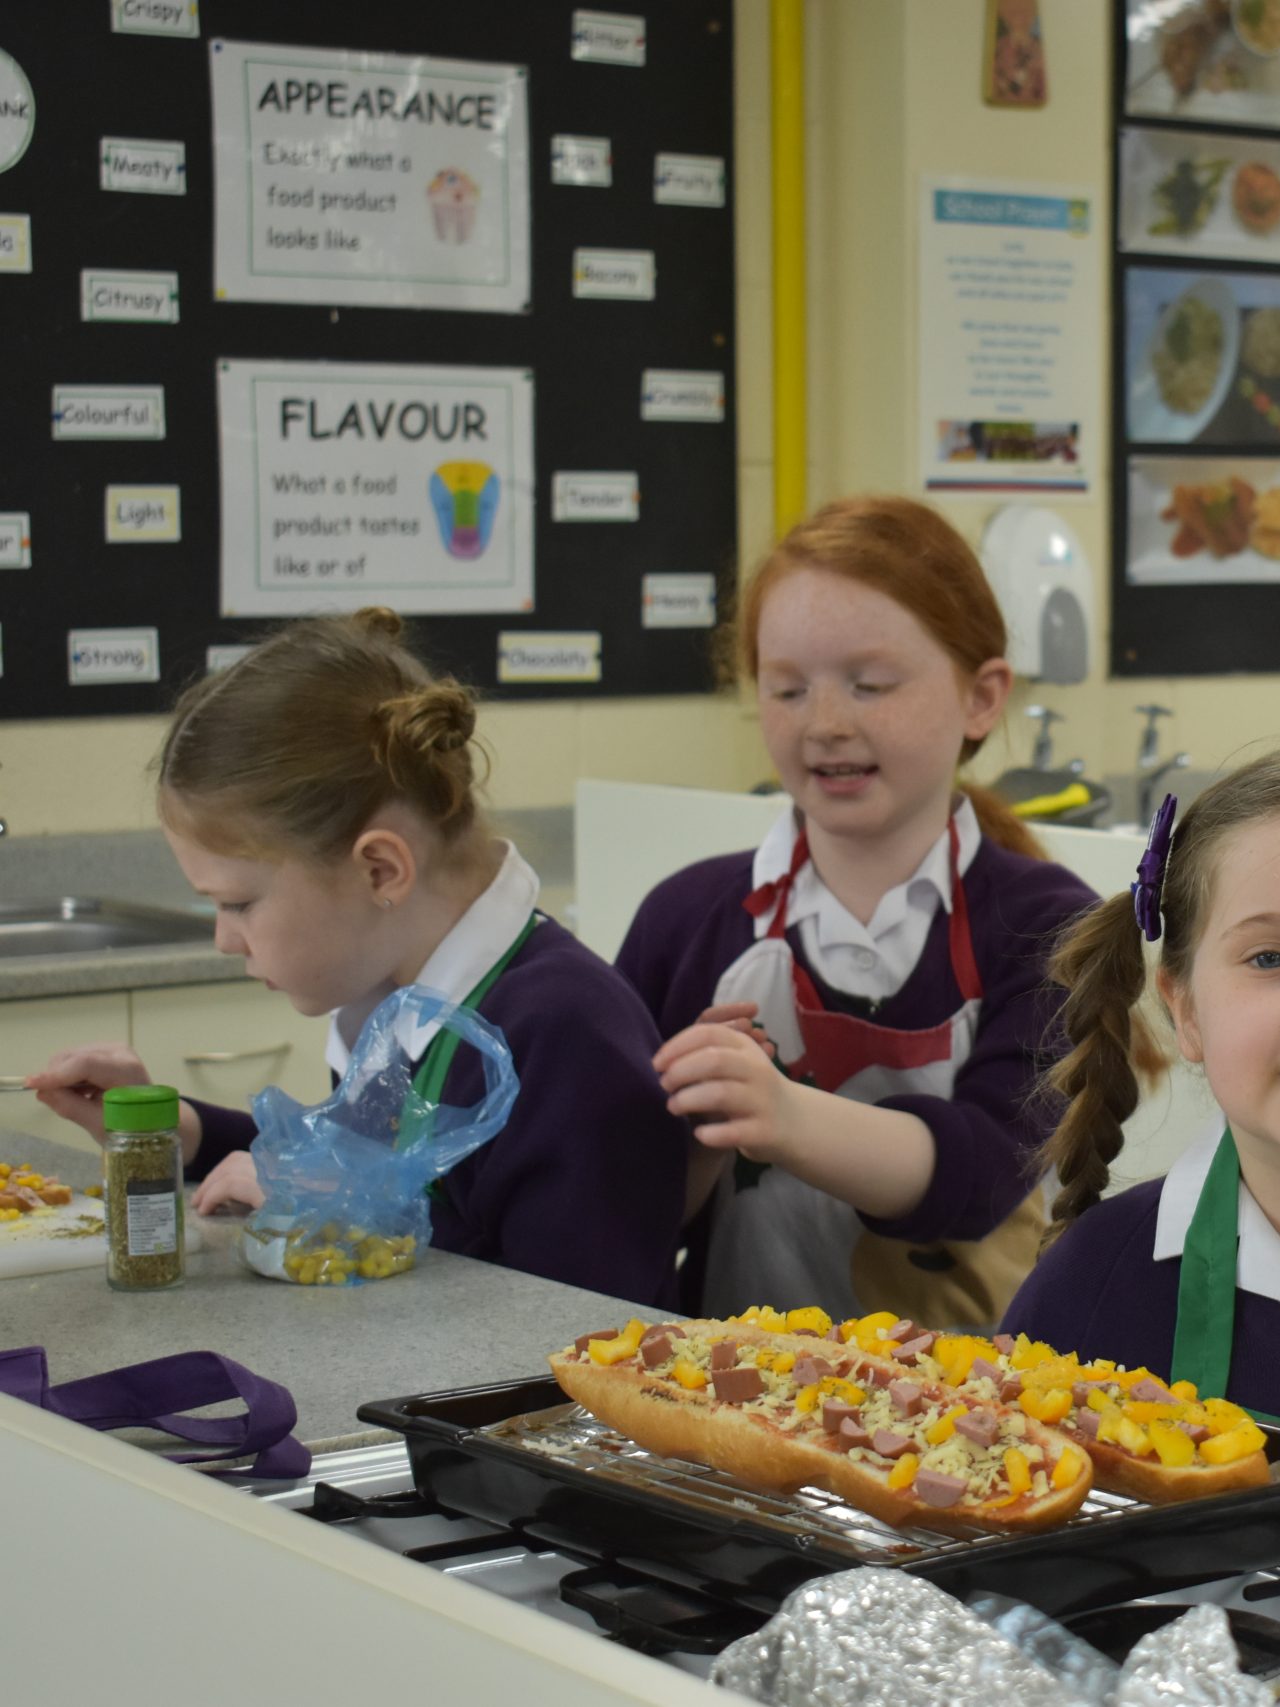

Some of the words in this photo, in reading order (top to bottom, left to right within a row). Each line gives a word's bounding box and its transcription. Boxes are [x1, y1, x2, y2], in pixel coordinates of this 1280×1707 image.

[123, 0, 184, 24] Crispy
[257, 79, 496, 131] APPEARANCE
[112, 155, 174, 181] Meaty
[263, 143, 340, 174] Exactly
[345, 151, 393, 173] what
[398, 155, 412, 173] a
[266, 184, 315, 208] food
[319, 188, 397, 214] product
[266, 226, 318, 250] looks
[324, 228, 361, 252] like
[94, 288, 165, 313] Citrusy
[62, 403, 149, 426] Colourful
[280, 398, 488, 442] FLAVOUR
[273, 473, 327, 495] What
[333, 481, 347, 496] a
[352, 473, 398, 496] food
[115, 503, 167, 529] Light
[274, 513, 352, 542] product
[359, 517, 421, 536] tastes
[274, 554, 312, 577] like
[316, 561, 341, 576] or
[345, 554, 367, 577] of
[79, 643, 146, 668] Strong
